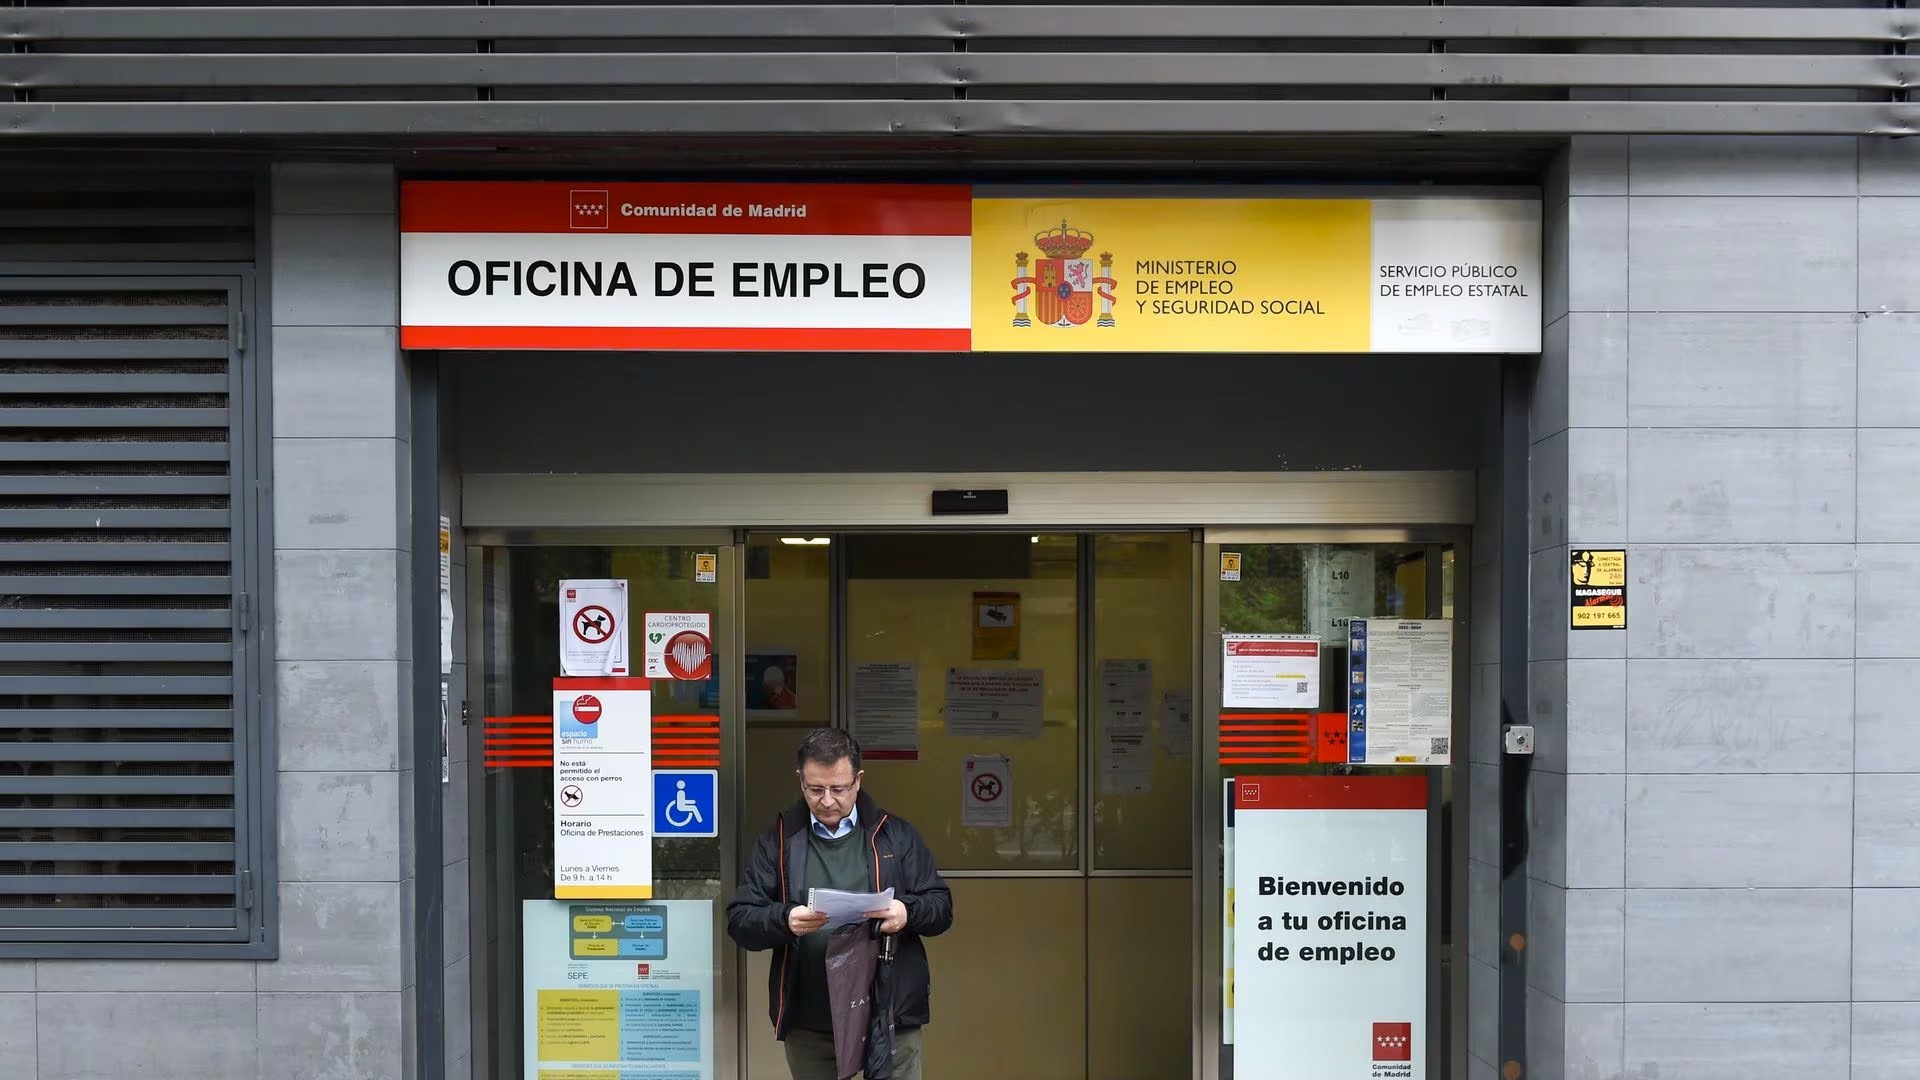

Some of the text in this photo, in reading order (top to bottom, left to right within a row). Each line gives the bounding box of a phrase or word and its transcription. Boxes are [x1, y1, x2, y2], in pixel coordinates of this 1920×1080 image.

[620, 203, 807, 218] Comunidad de Madrid
[1136, 260, 1237, 275] MINISTERIO
[1379, 262, 1518, 278] SERVICIO PÚBLICO
[447, 260, 926, 299] OFICINA DE EMPLEO
[1136, 280, 1234, 295] DE EMPLEO
[1380, 284, 1529, 297] DE EMPLEO ESTATAL
[1136, 300, 1326, 315] Y SEGURIDAD SOCIAL
[1332, 571, 1349, 580] L10
[561, 731, 588, 739] espacio
[560, 820, 592, 828] Horario
[560, 828, 586, 836] Oficina
[560, 864, 584, 872] Lunes
[591, 864, 620, 872] Viernes
[560, 874, 571, 882] De
[572, 874, 578, 882] 9
[1259, 876, 1404, 896] Bienvenido
[1258, 911, 1406, 930] a tu oficina
[1258, 942, 1396, 965] de empleo
[568, 972, 588, 980] SEPE
